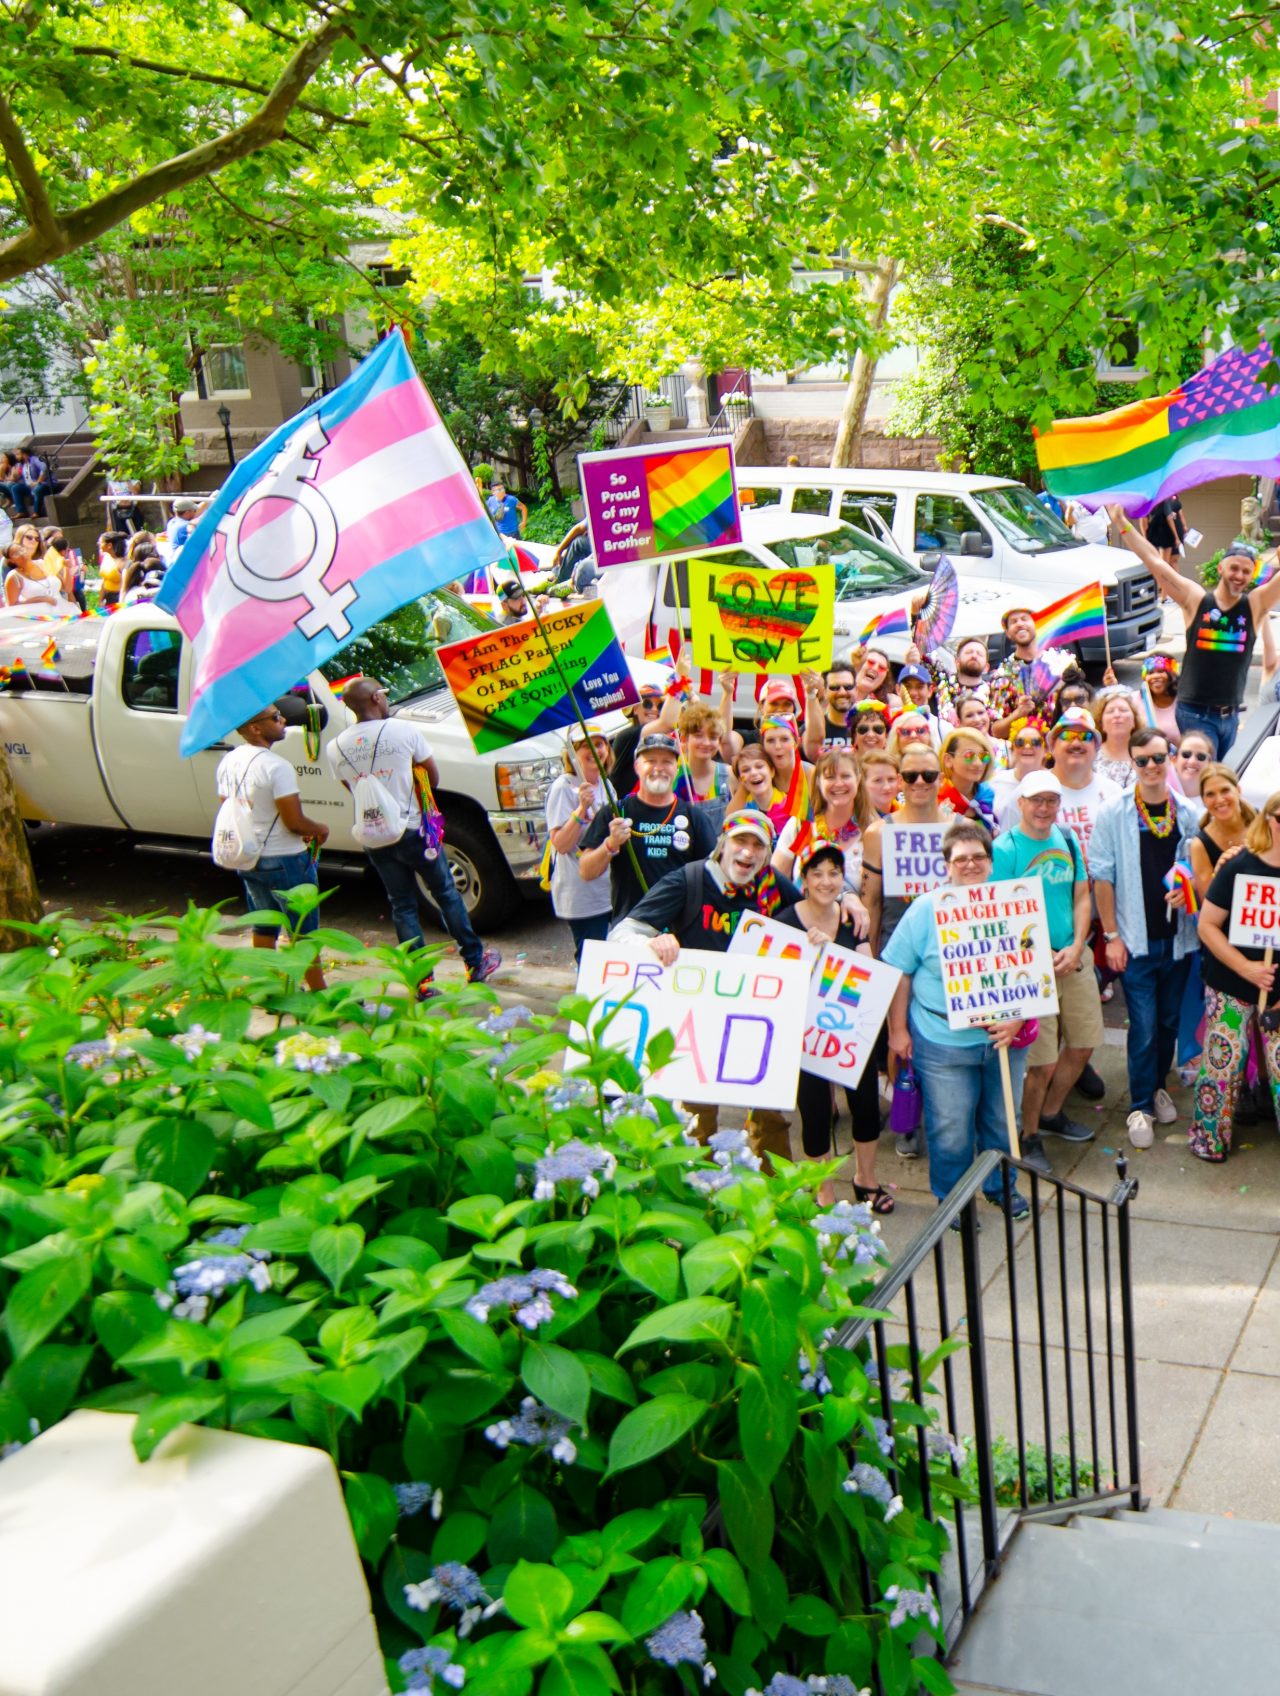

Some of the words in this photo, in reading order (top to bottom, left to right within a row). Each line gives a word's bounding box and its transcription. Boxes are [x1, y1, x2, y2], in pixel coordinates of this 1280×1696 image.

[609, 473, 627, 487] So
[601, 486, 641, 504] Proud
[601, 507, 617, 521] of
[619, 505, 641, 519] my
[611, 521, 639, 536] Gay
[603, 535, 651, 553] Brother
[708, 574, 820, 612] LOVE
[460, 650, 468, 661] I
[472, 644, 499, 658] Am
[500, 632, 530, 649] The
[533, 612, 586, 639] LUCKY
[468, 653, 522, 680] PFLAG
[525, 638, 575, 662] Parent
[709, 633, 821, 664] LOVE
[476, 682, 496, 697] Of
[499, 677, 520, 692] An
[582, 675, 603, 692] Love
[602, 671, 620, 687] You
[483, 695, 519, 717] GAY
[521, 681, 565, 705] SON!!
[589, 688, 627, 711] Stephen!
[639, 822, 677, 833] PROTECT
[644, 835, 672, 845] TRANS
[894, 831, 943, 853] FRE
[647, 847, 668, 857] KIDS
[894, 856, 948, 877] HUG
[904, 881, 946, 894] PFLA
[968, 886, 997, 902] MY
[936, 898, 1039, 926] DAUGHTER
[940, 928, 960, 945] IS
[969, 920, 1010, 941] THE
[943, 938, 992, 961] GOLD
[997, 935, 1018, 953] AT
[945, 957, 988, 977] THE
[994, 950, 1034, 970] END
[602, 960, 784, 999] PROUD
[947, 976, 973, 994] OF
[979, 972, 1009, 989] MY
[950, 982, 1040, 1012] RAINBOW
[969, 1010, 1022, 1024] PFLAG
[599, 1000, 775, 1086] DAD
